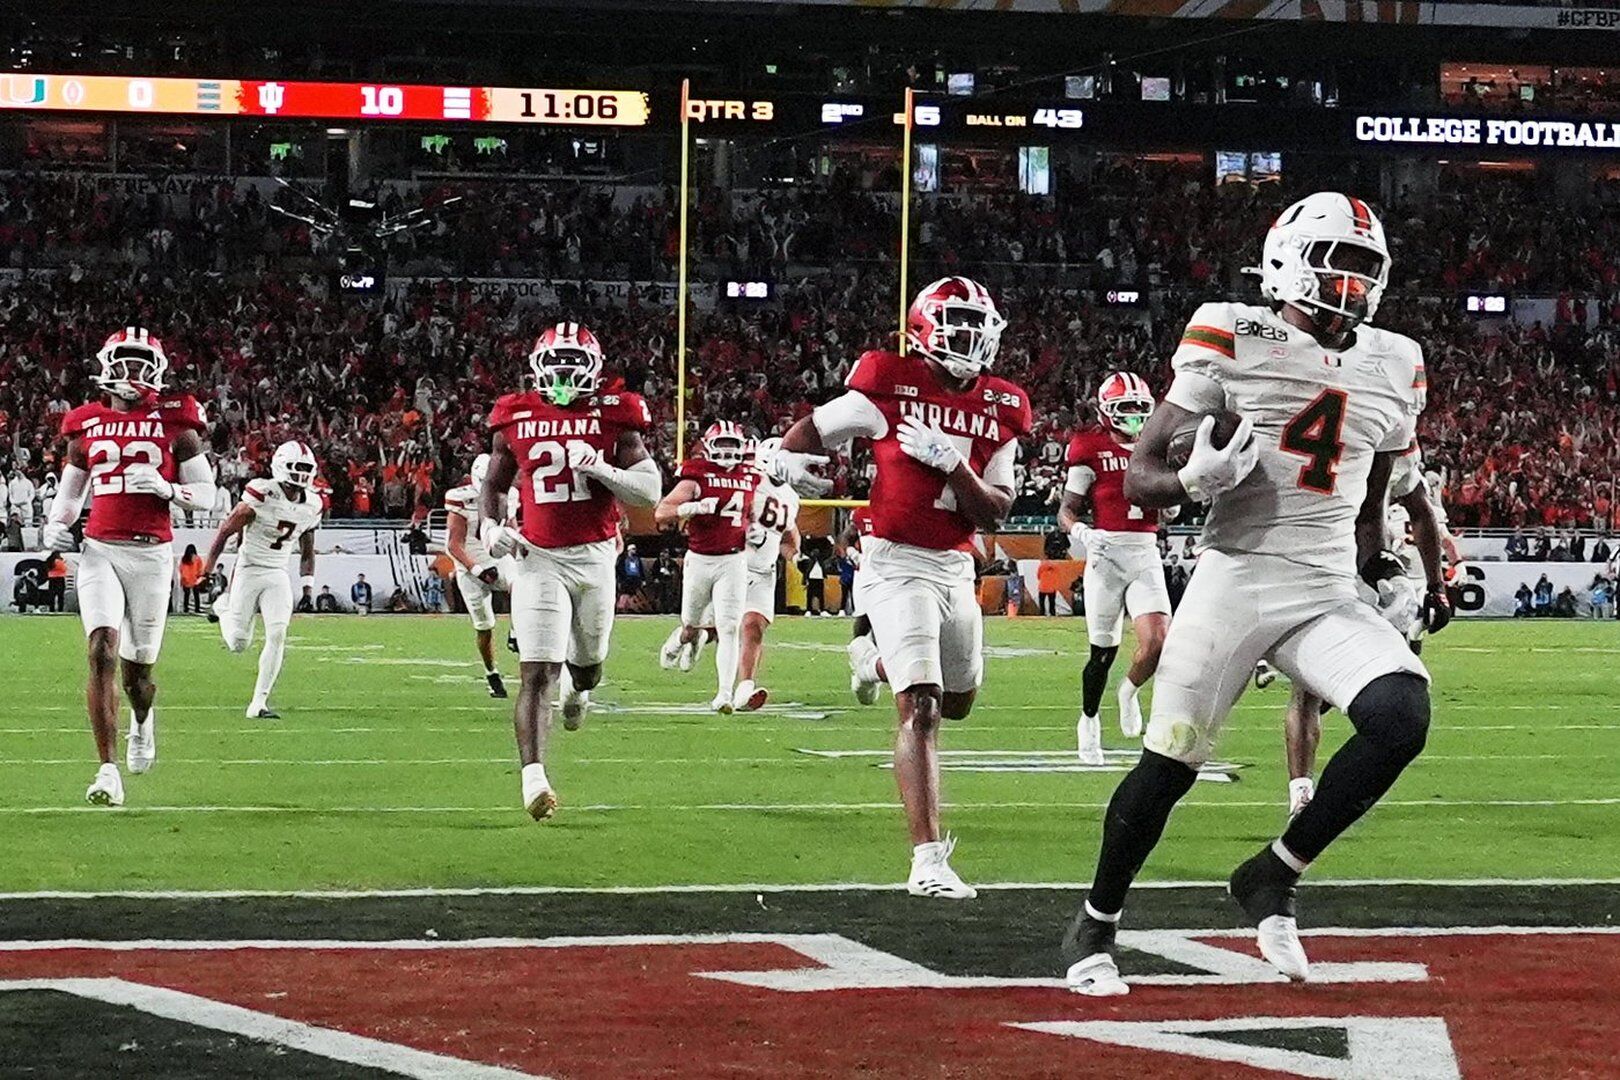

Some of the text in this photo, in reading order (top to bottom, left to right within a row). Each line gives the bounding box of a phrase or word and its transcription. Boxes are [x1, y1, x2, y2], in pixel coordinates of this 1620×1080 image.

[128, 79, 152, 108] 0
[360, 86, 403, 115] 10
[521, 92, 618, 118] 11:06
[687, 100, 774, 122] QTR 3
[821, 103, 864, 122] 2ND
[966, 109, 1083, 128] BALL ON 43
[1356, 116, 1480, 143] COLLEGE
[1235, 318, 1288, 342] 2026
[86, 421, 165, 438] INDIANA
[517, 419, 601, 439] INDIANA
[900, 400, 1000, 442] INDIANA
[1279, 388, 1348, 495] 4
[759, 497, 788, 532] 61
[270, 520, 297, 550] 7
